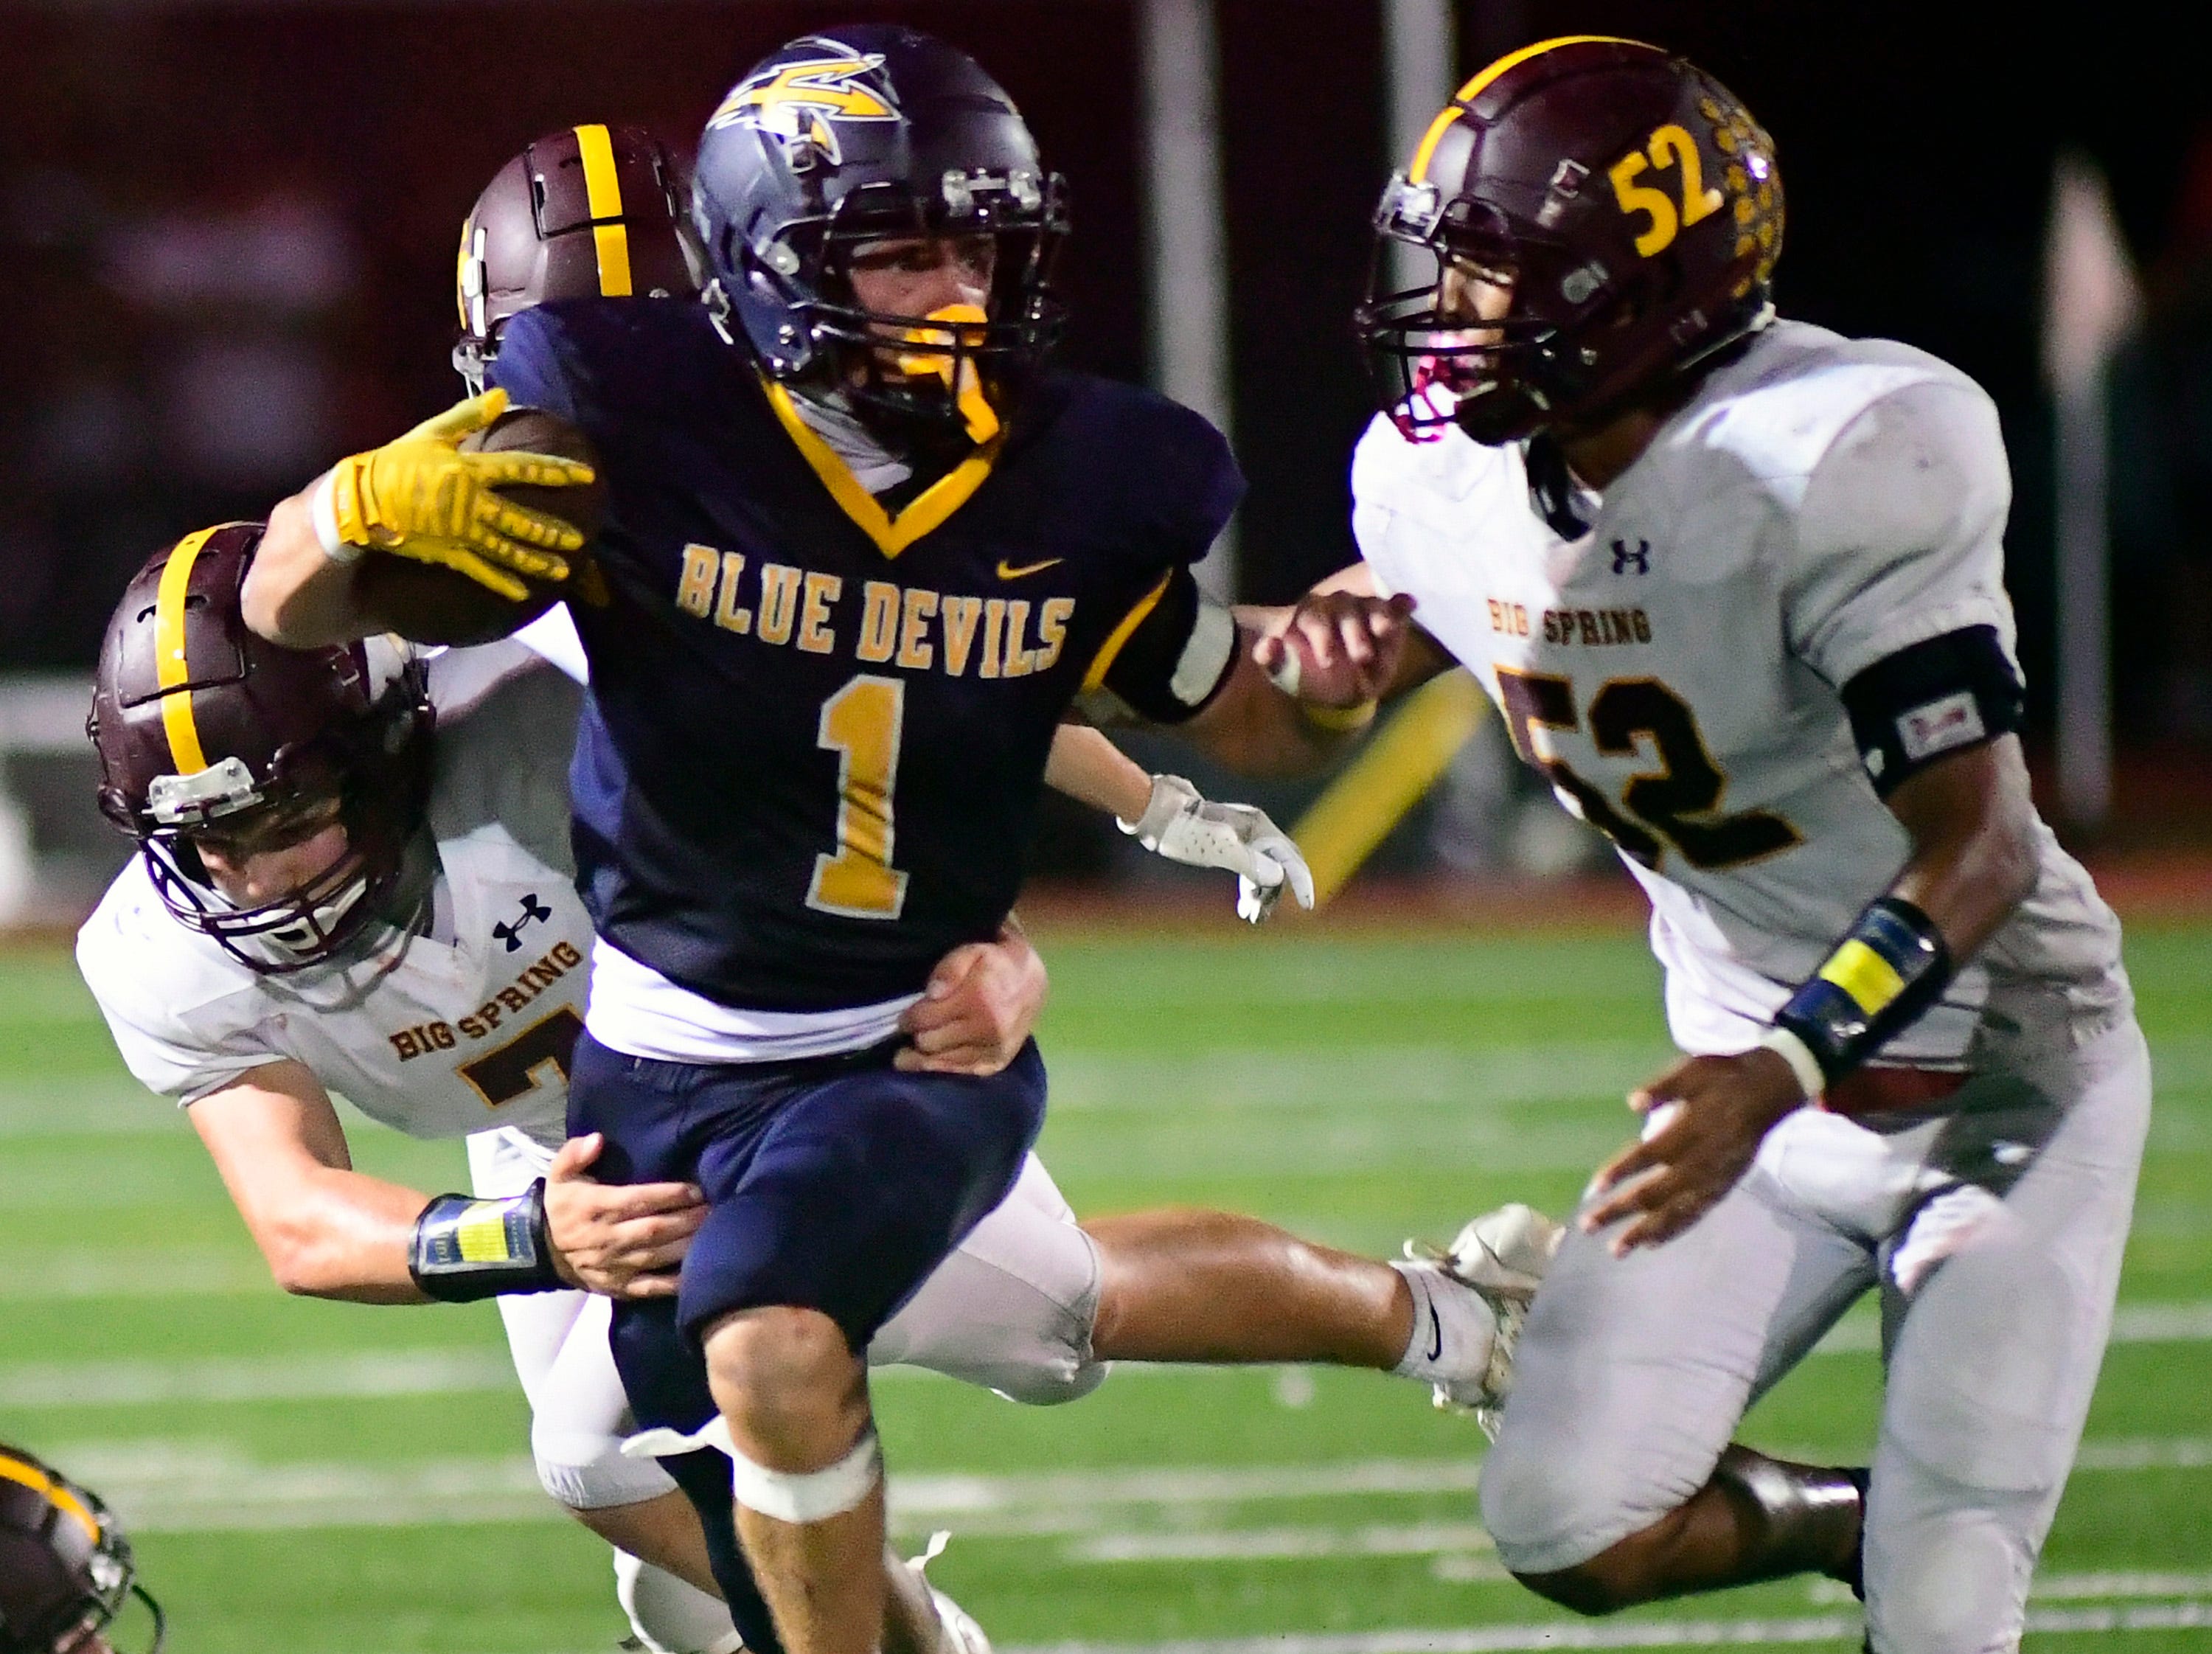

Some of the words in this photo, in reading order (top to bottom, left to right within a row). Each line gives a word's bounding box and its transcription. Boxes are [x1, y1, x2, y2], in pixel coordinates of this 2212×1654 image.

[1608, 124, 1725, 258] 52
[675, 542, 842, 655] BLUE
[856, 580, 1076, 679] DEVILS
[1487, 598, 1530, 636] BIG
[1543, 608, 1652, 646] SPRING
[804, 673, 909, 920] 1
[1492, 662, 1805, 873] 52
[389, 1020, 456, 1062] BIG
[457, 940, 584, 1039] SPRING
